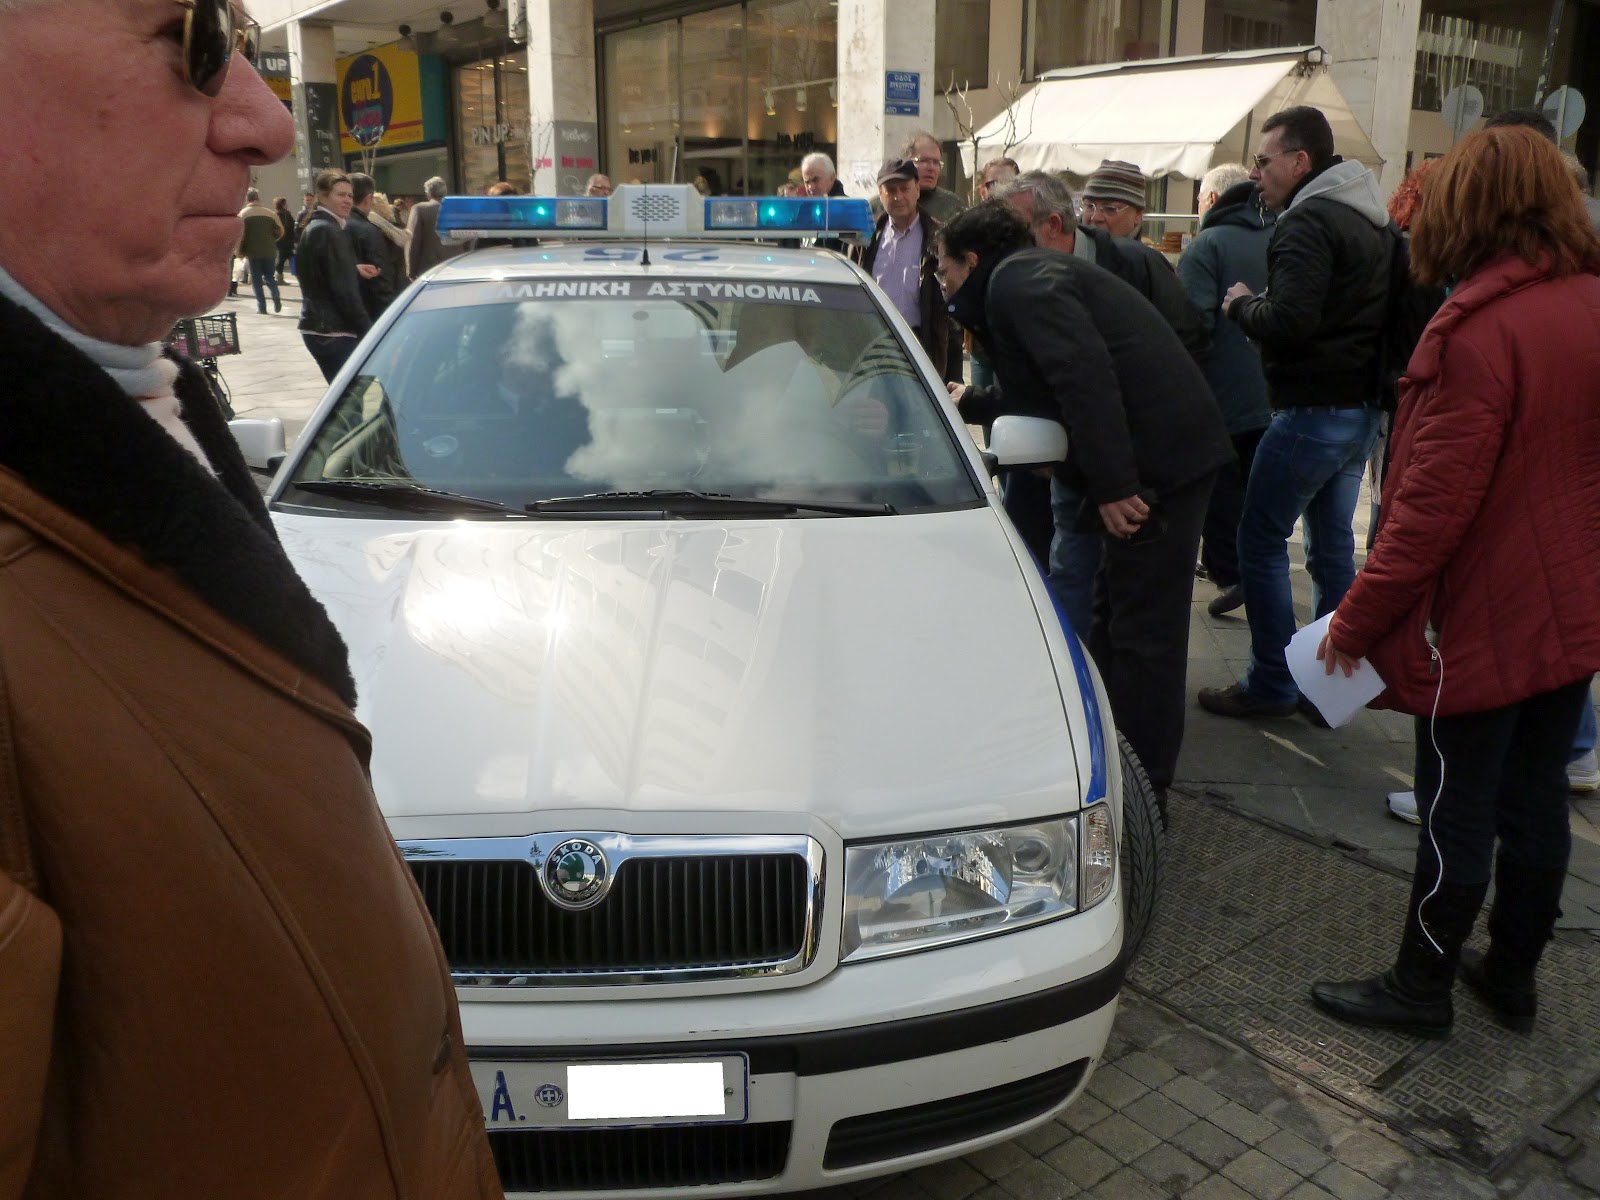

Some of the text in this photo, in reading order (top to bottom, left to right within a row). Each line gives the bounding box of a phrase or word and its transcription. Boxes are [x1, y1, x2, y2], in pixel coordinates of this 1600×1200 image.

[265, 57, 288, 71] UP
[894, 74, 911, 82] ΟΔΟΣ
[480, 281, 822, 303] ΛΛΗΝΙΚΗ ΑΣΤΥΝΟΜΙΑ
